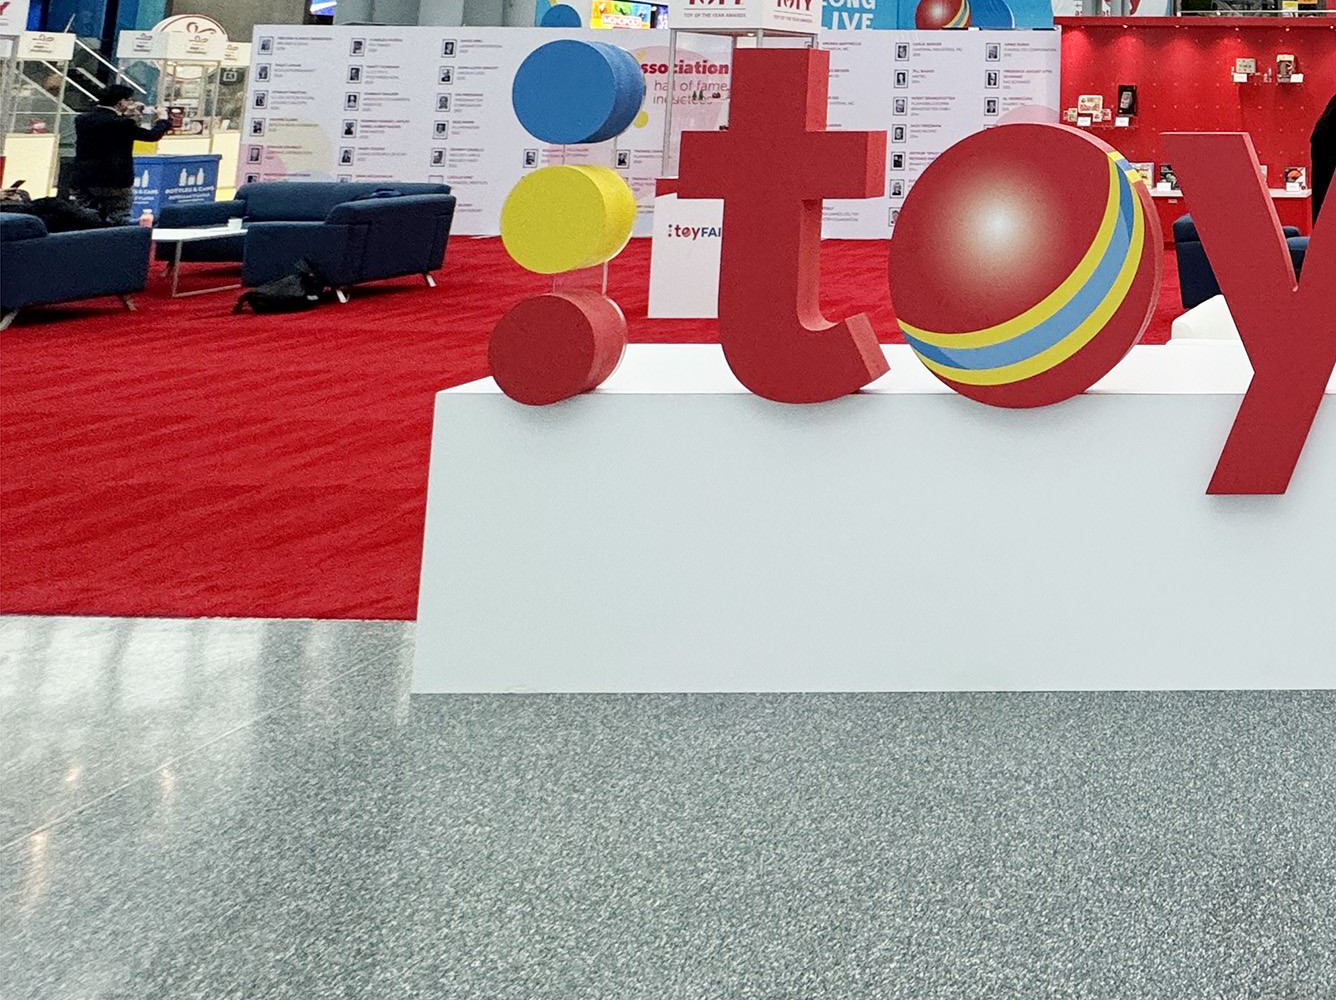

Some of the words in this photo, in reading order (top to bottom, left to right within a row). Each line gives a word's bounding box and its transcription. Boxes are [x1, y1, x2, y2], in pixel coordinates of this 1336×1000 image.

[821, 11, 875, 30] IVE
[640, 60, 729, 75] ssoiation
[654, 79, 677, 92] hal
[680, 79, 693, 91] of
[696, 79, 728, 92] fame
[674, 224, 722, 241] toyFAI
